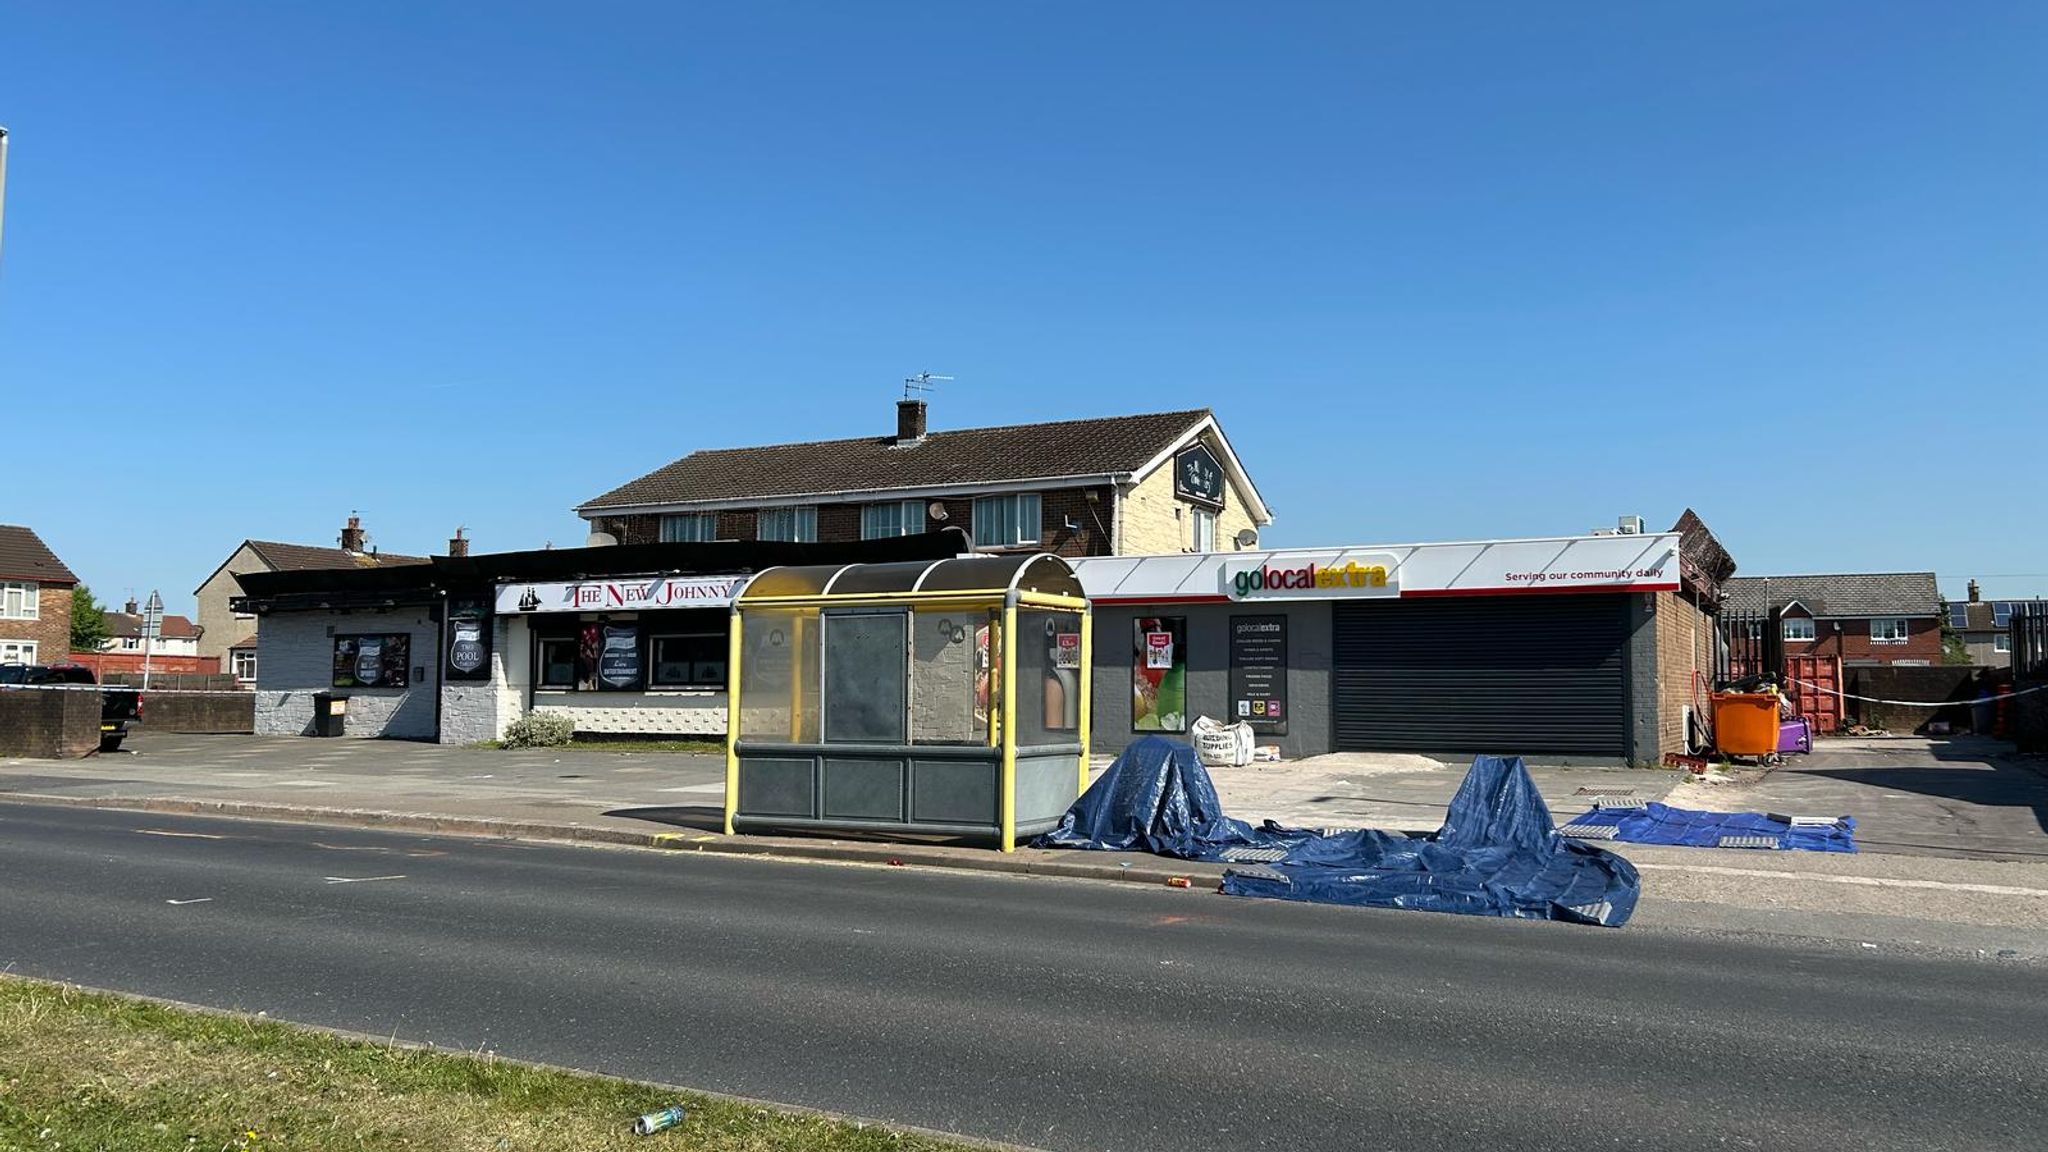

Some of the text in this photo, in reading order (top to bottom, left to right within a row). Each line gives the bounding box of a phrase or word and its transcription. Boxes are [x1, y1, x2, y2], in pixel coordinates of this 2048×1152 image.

[1235, 561, 1387, 596] golocalextra
[1505, 568, 1664, 582] Serving our community daily
[566, 582, 732, 608] THE NEW JOHNNY
[456, 651, 480, 661] POOL
[1202, 742, 1233, 751] SUPPLIES
